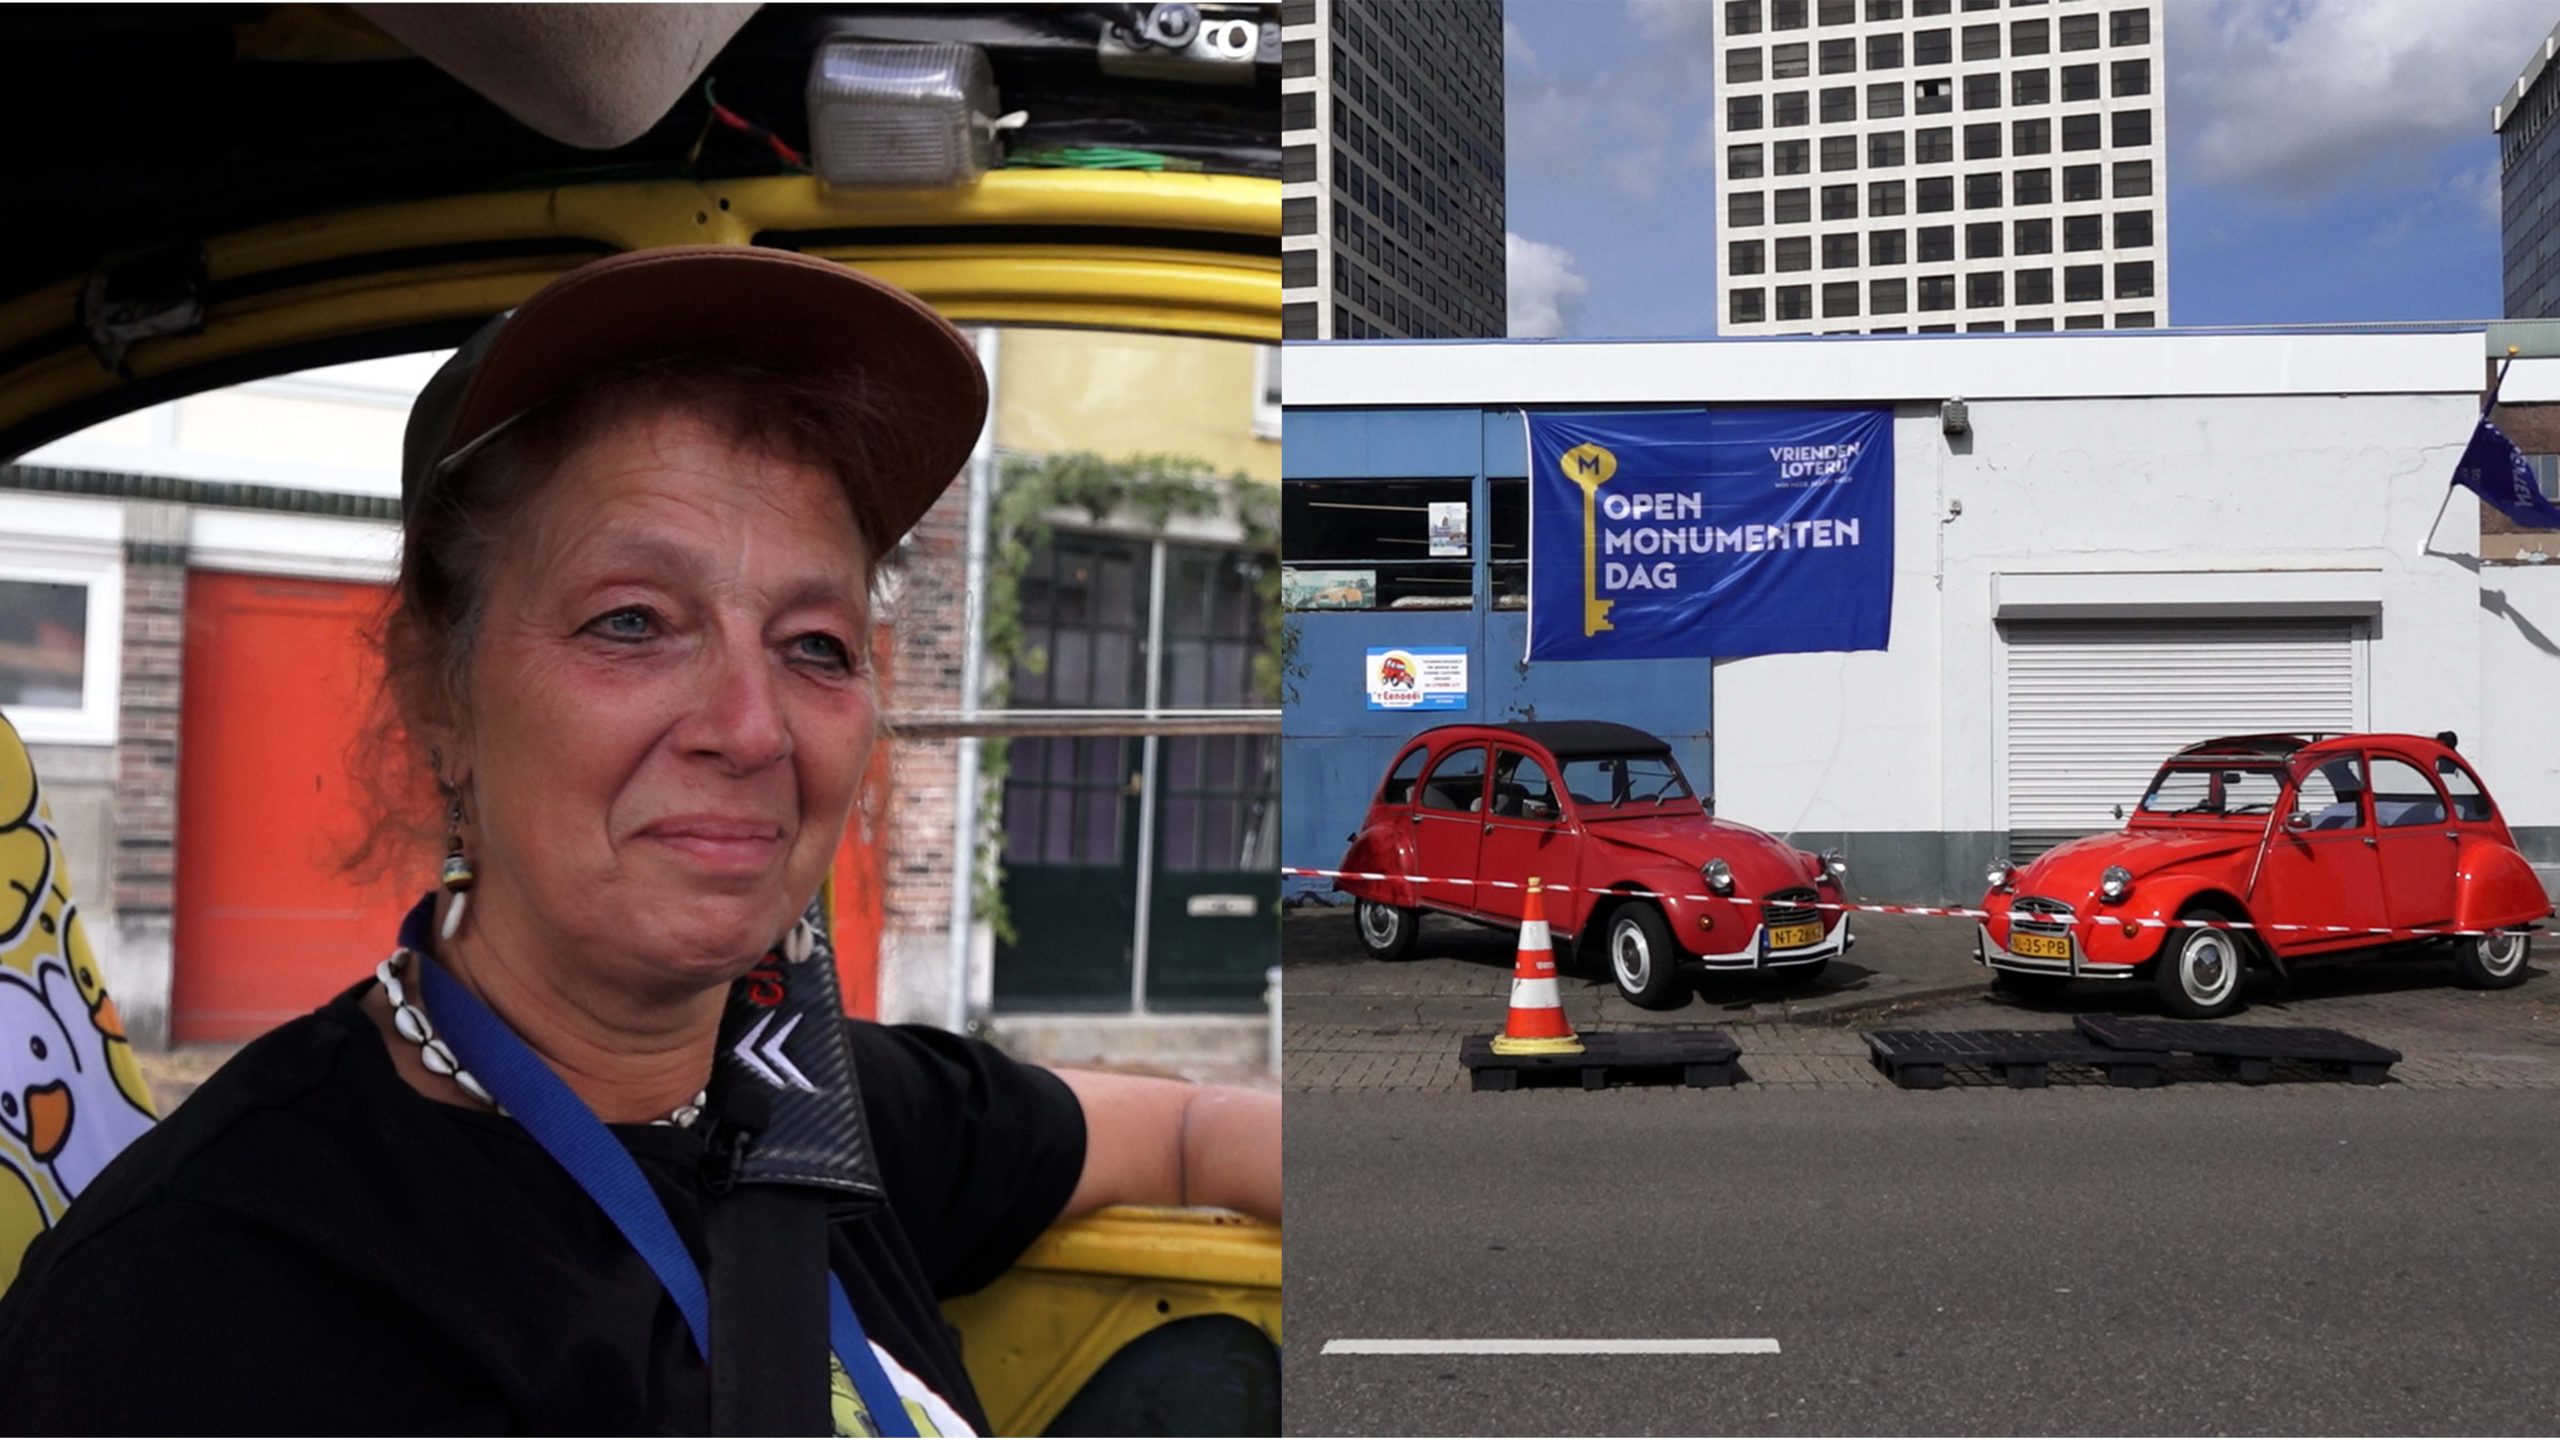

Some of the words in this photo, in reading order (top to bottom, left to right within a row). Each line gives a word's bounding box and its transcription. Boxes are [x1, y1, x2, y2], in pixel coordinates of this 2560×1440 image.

[1769, 442, 1860, 462] VRIENDEN
[1578, 454, 1600, 475] M
[1781, 458, 1848, 479] LOTERIJ
[1603, 492, 1702, 521] OPEN
[1605, 518, 1861, 556] MONUMENTEN
[1605, 562, 1678, 590] DAG
